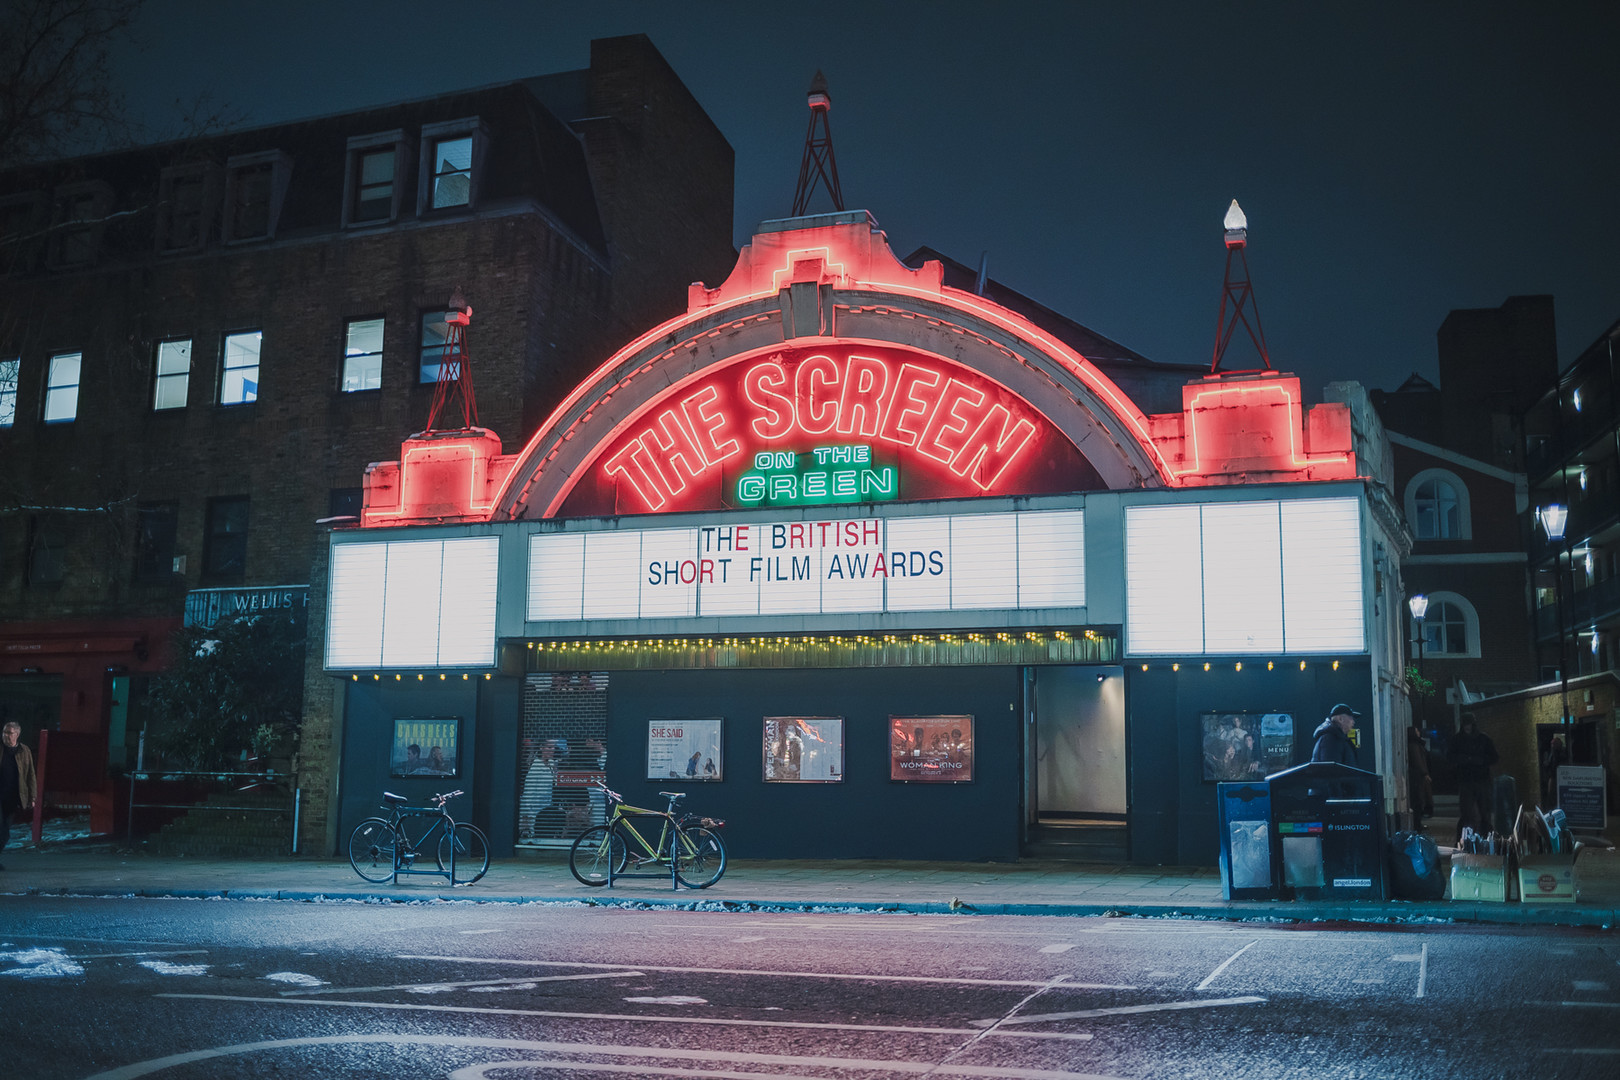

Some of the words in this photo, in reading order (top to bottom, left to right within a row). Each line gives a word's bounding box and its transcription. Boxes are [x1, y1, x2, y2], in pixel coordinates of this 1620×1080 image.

[603, 384, 741, 511] THE
[744, 354, 1036, 491] SCREEN
[753, 450, 796, 471] ON
[813, 444, 872, 465] THE
[737, 466, 892, 502] GREEN
[701, 525, 749, 553] THE
[772, 519, 880, 550] BRITISH
[648, 557, 733, 586] SHORT
[748, 554, 811, 583] FILM
[827, 550, 944, 580] AWARDS
[234, 592, 293, 610] WELLS
[397, 723, 455, 738] BANSHEES
[651, 728, 666, 738] SHE
[667, 728, 684, 738] SAID
[900, 761, 937, 769] WOMAN
[939, 761, 963, 769] KING
[1334, 823, 1371, 831] ISLINGTON
